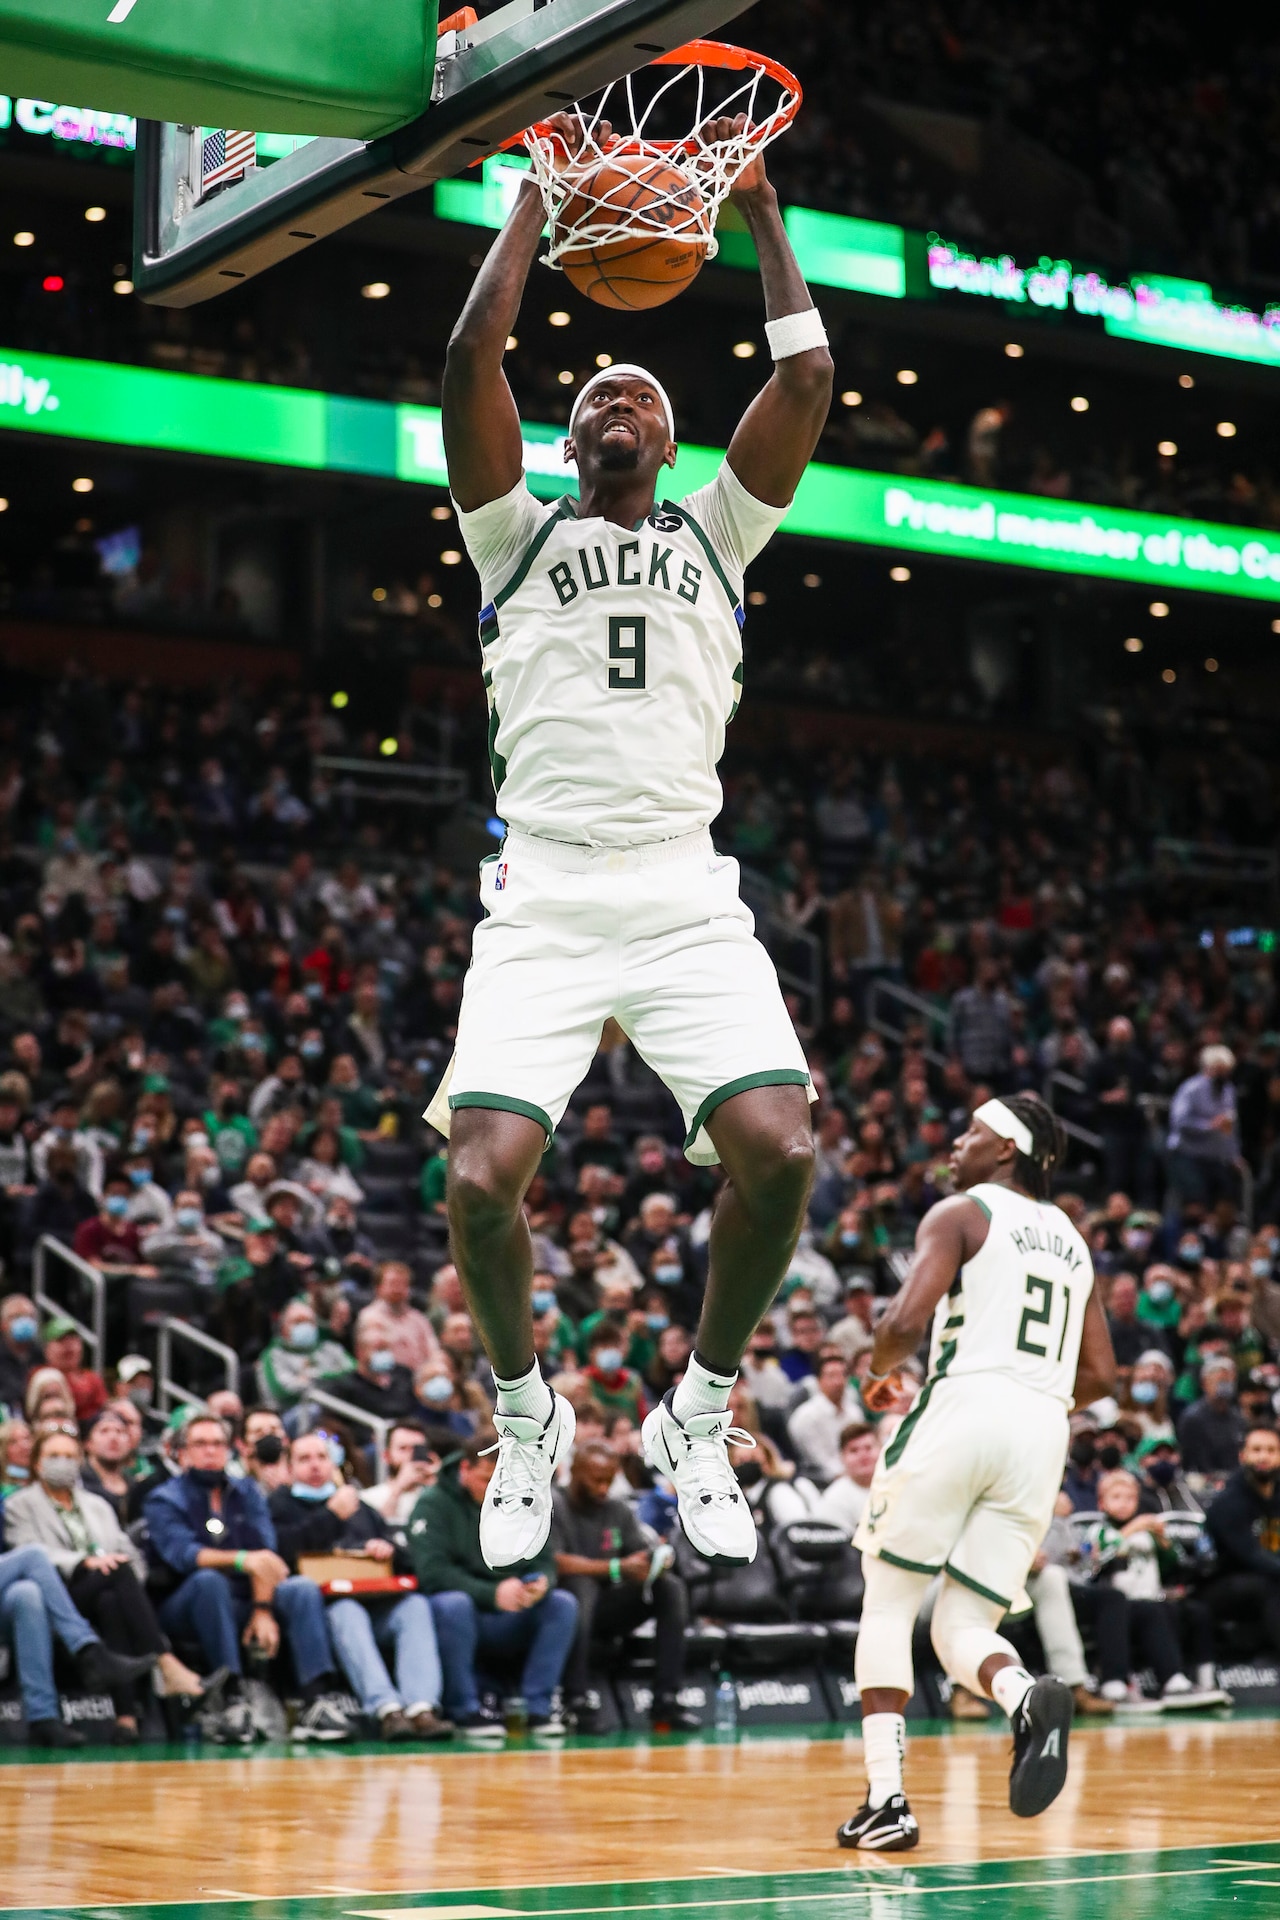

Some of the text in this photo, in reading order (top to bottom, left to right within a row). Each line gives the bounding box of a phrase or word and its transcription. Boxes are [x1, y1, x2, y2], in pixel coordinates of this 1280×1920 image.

[885, 487, 995, 541] Proud
[997, 513, 1142, 561] member
[1143, 528, 1183, 567] of
[1183, 532, 1240, 576] the
[547, 540, 702, 607] BUCKS
[607, 615, 647, 690] 9
[1010, 1226, 1082, 1272] HOLIDAY
[1017, 1273, 1071, 1362] 21
